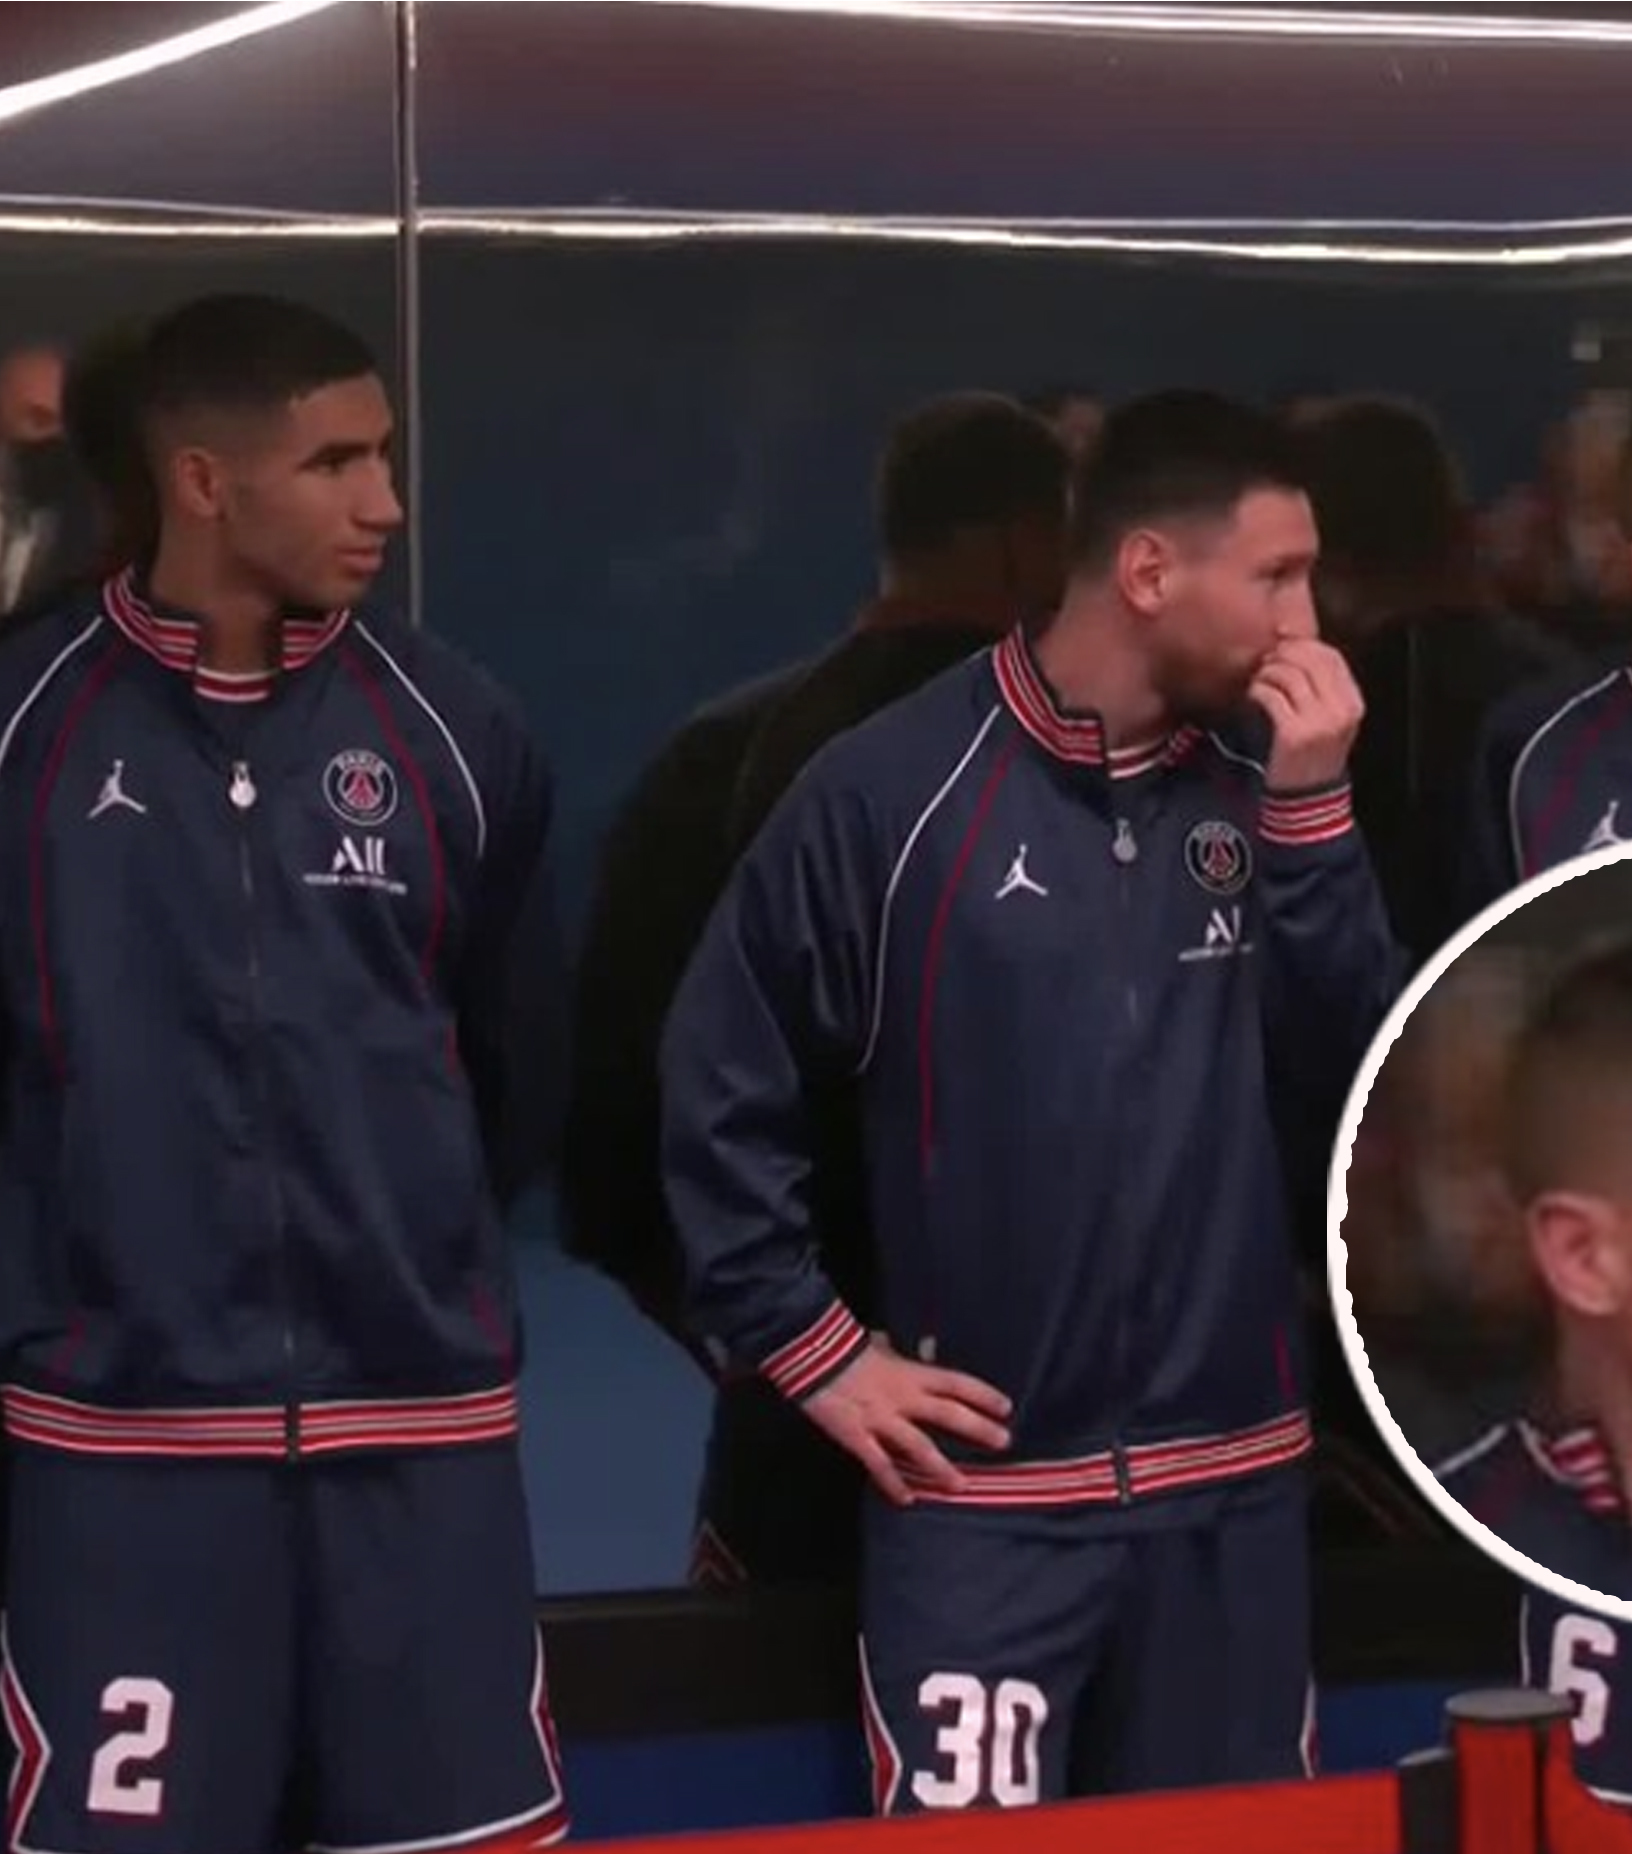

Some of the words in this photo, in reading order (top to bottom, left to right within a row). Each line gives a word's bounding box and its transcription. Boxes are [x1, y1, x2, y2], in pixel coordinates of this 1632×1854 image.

[86, 1676, 174, 1816] 2
[911, 1670, 1049, 1809] 30
[1549, 1613, 1618, 1746] 6
